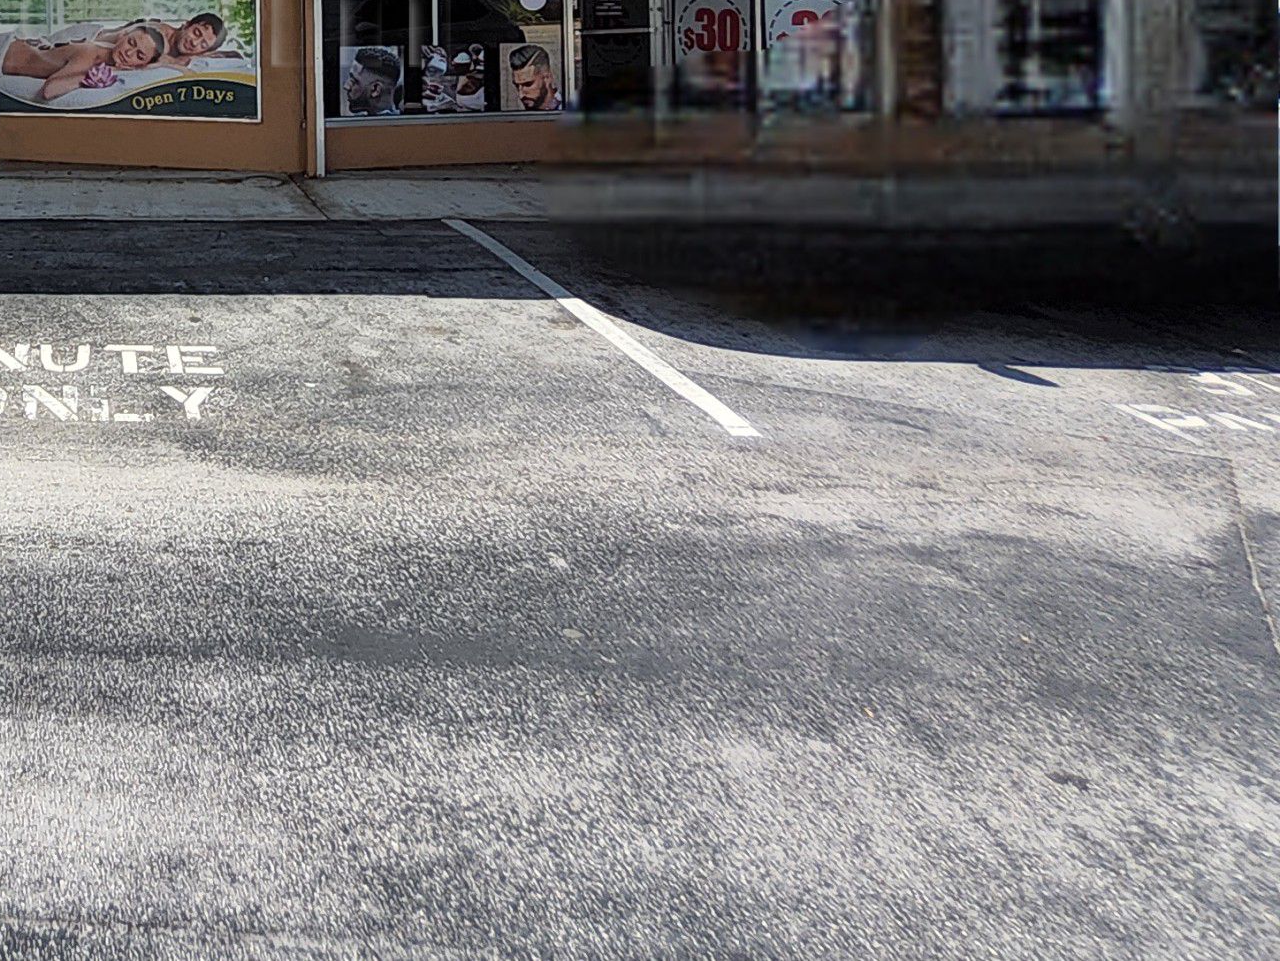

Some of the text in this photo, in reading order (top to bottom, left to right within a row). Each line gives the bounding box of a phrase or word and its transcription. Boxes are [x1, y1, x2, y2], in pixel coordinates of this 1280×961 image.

[683, 8, 740, 51] $30
[132, 86, 234, 110] Open 7 Days
